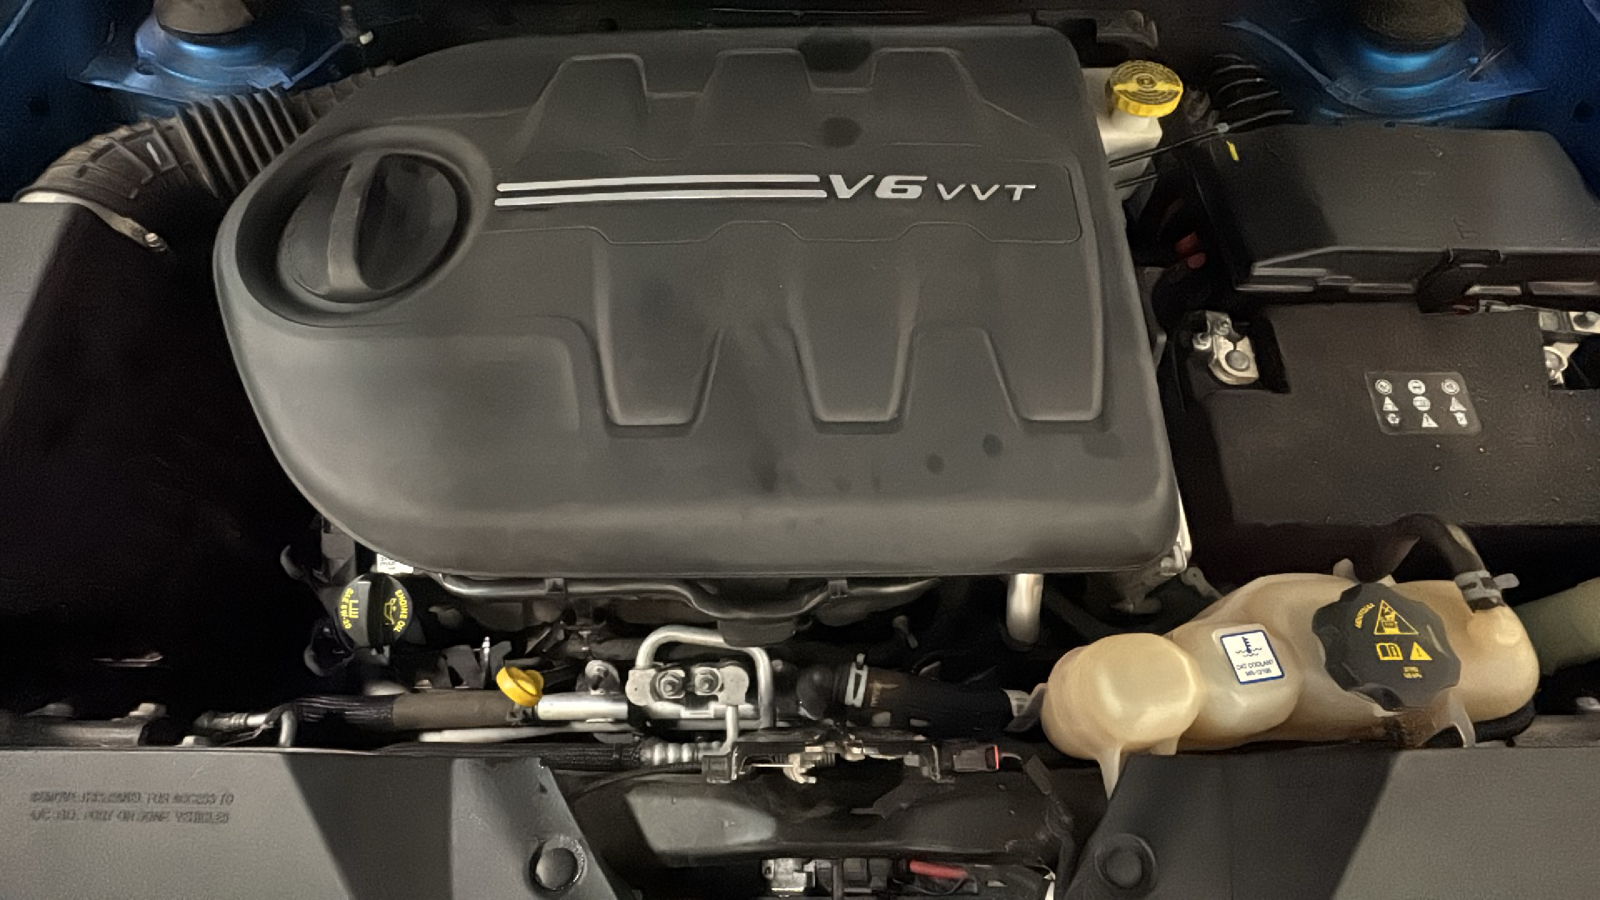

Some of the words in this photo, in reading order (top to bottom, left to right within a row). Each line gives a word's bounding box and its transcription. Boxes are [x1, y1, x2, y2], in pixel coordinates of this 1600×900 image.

[829, 174, 928, 199] V6
[936, 182, 1037, 201] VVT
[394, 589, 408, 619] ENGINE
